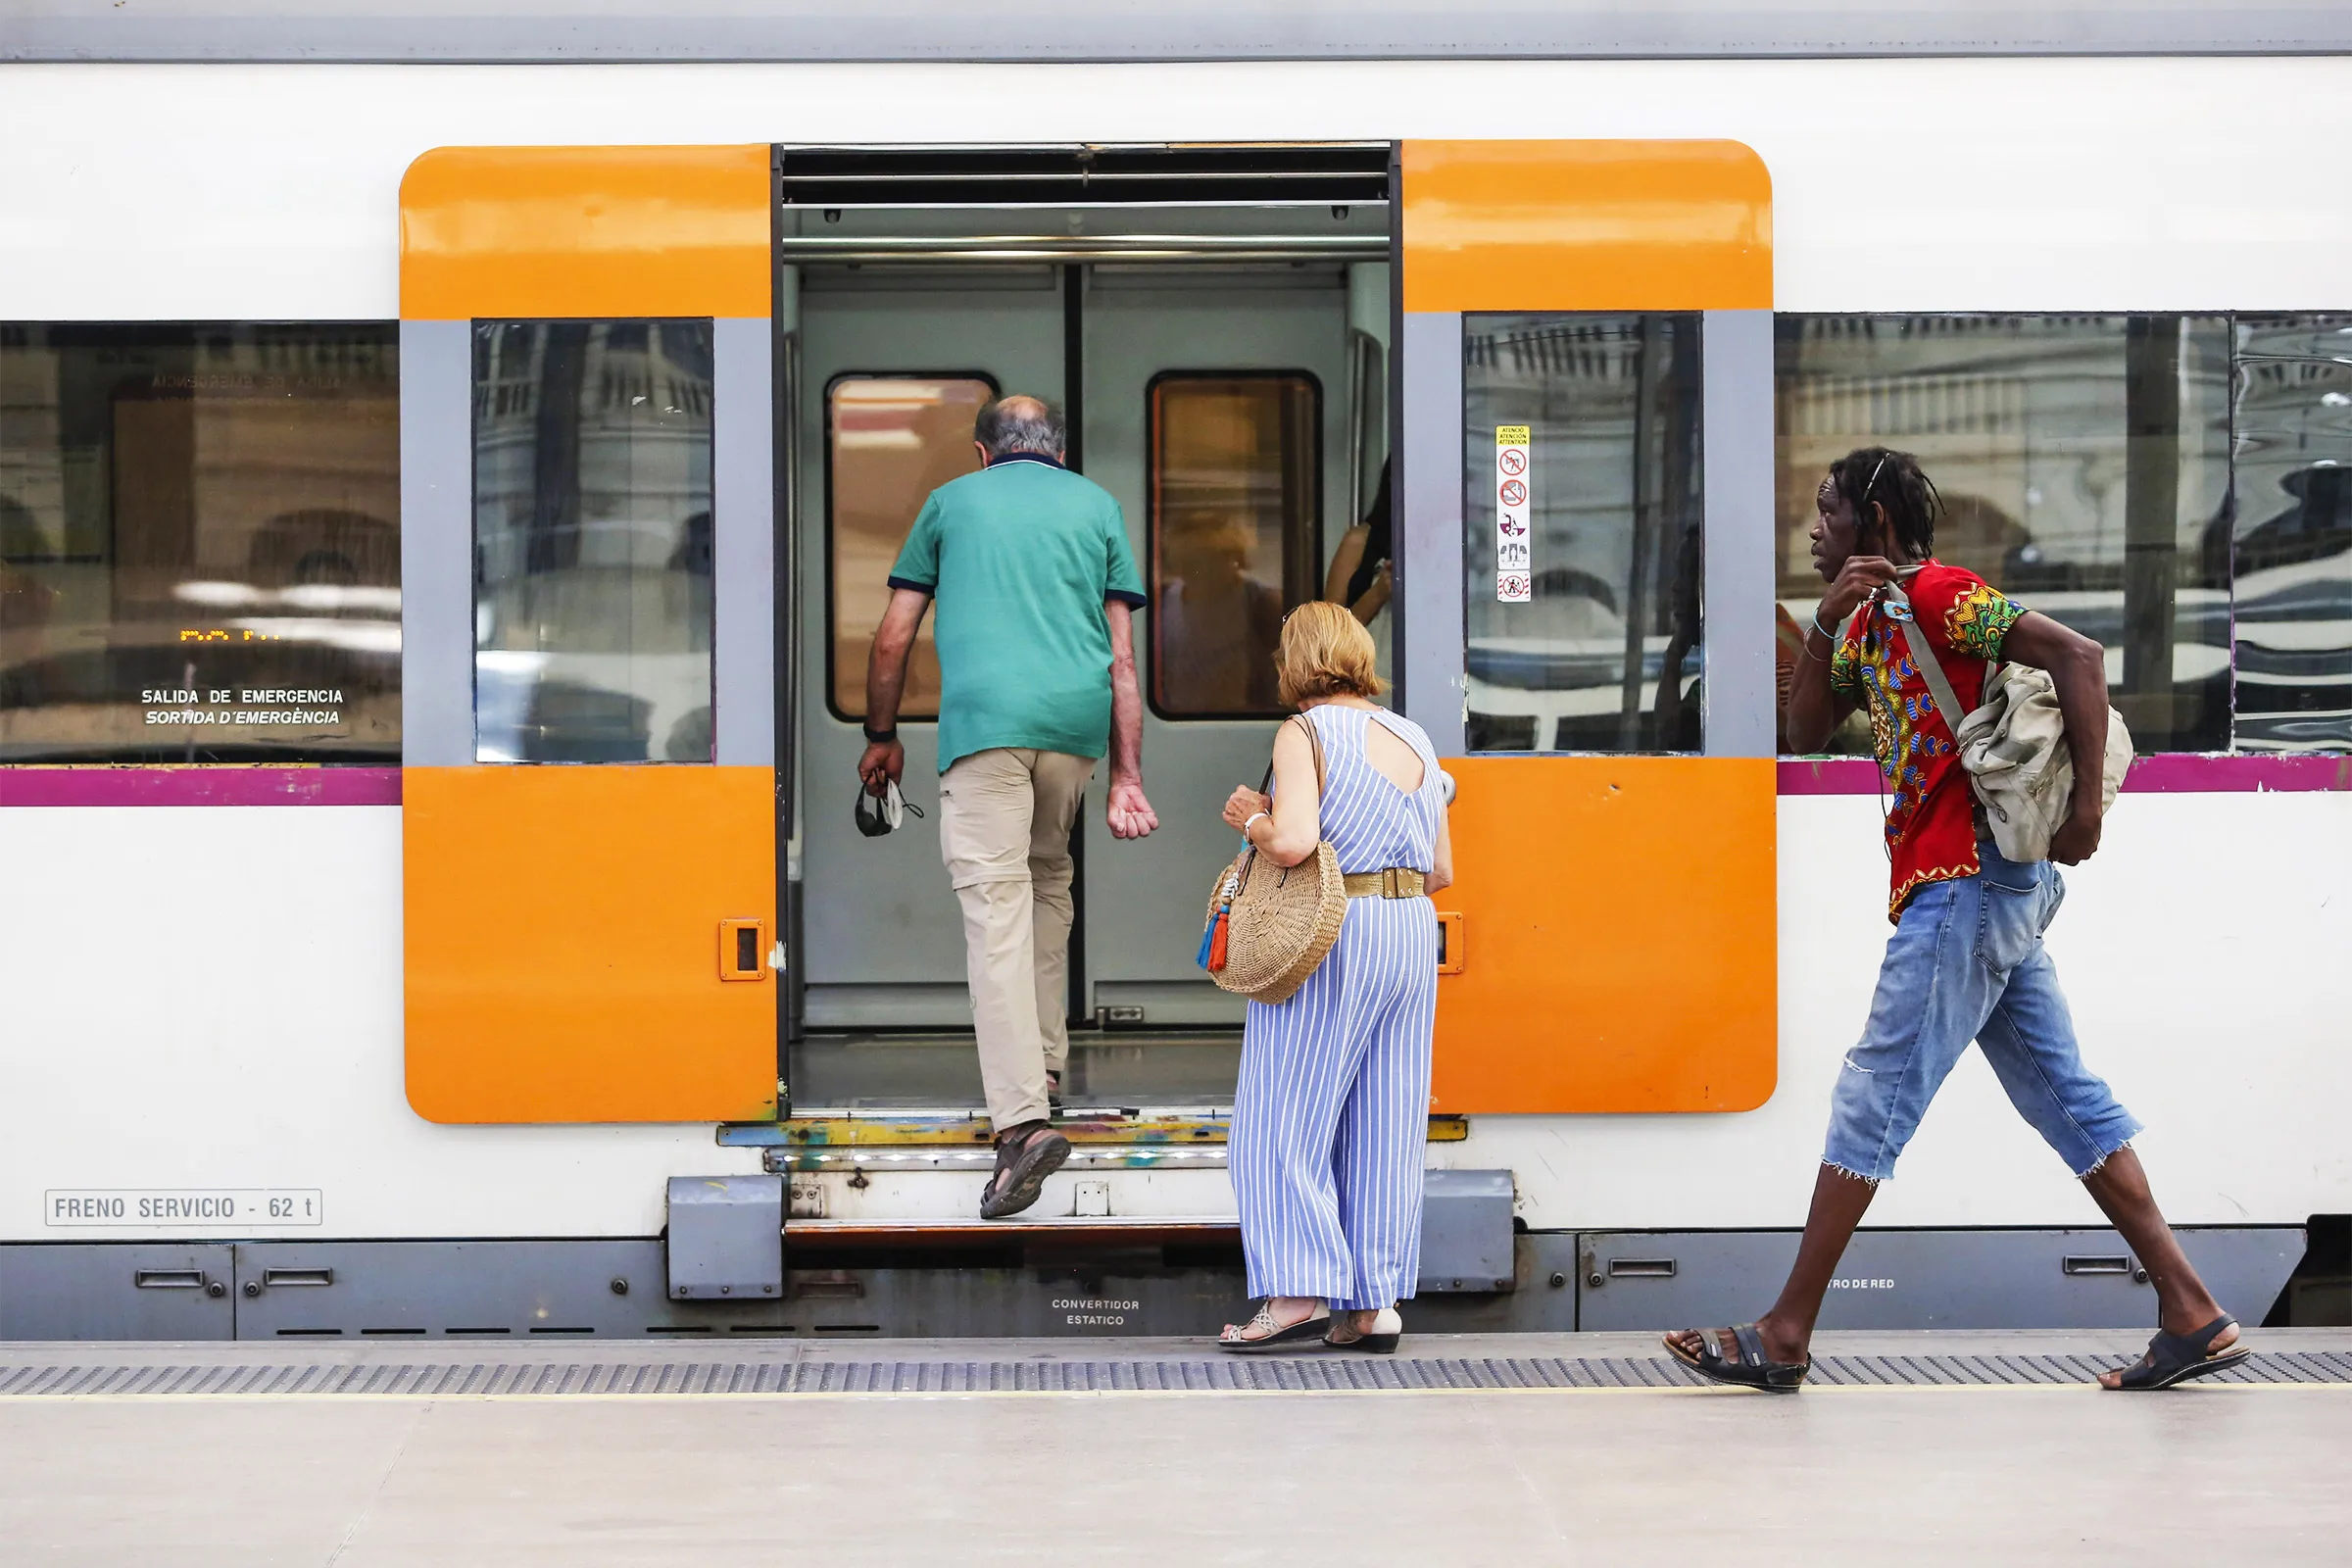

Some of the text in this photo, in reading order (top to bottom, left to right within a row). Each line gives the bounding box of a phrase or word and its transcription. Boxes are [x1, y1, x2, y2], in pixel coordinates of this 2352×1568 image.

[141, 689, 343, 704] SALIDA DE EMERGENCIA
[145, 710, 216, 724] SORTIDA
[55, 1198, 125, 1218] FRENO
[138, 1198, 235, 1218] SERVICIO
[269, 1198, 293, 1218] 62
[305, 1198, 313, 1217] t
[1852, 1279, 1868, 1289] DE
[1870, 1279, 1894, 1289] RED
[1052, 1298, 1140, 1310] CONVERTIDOR
[1066, 1314, 1124, 1326] ESTATICO
